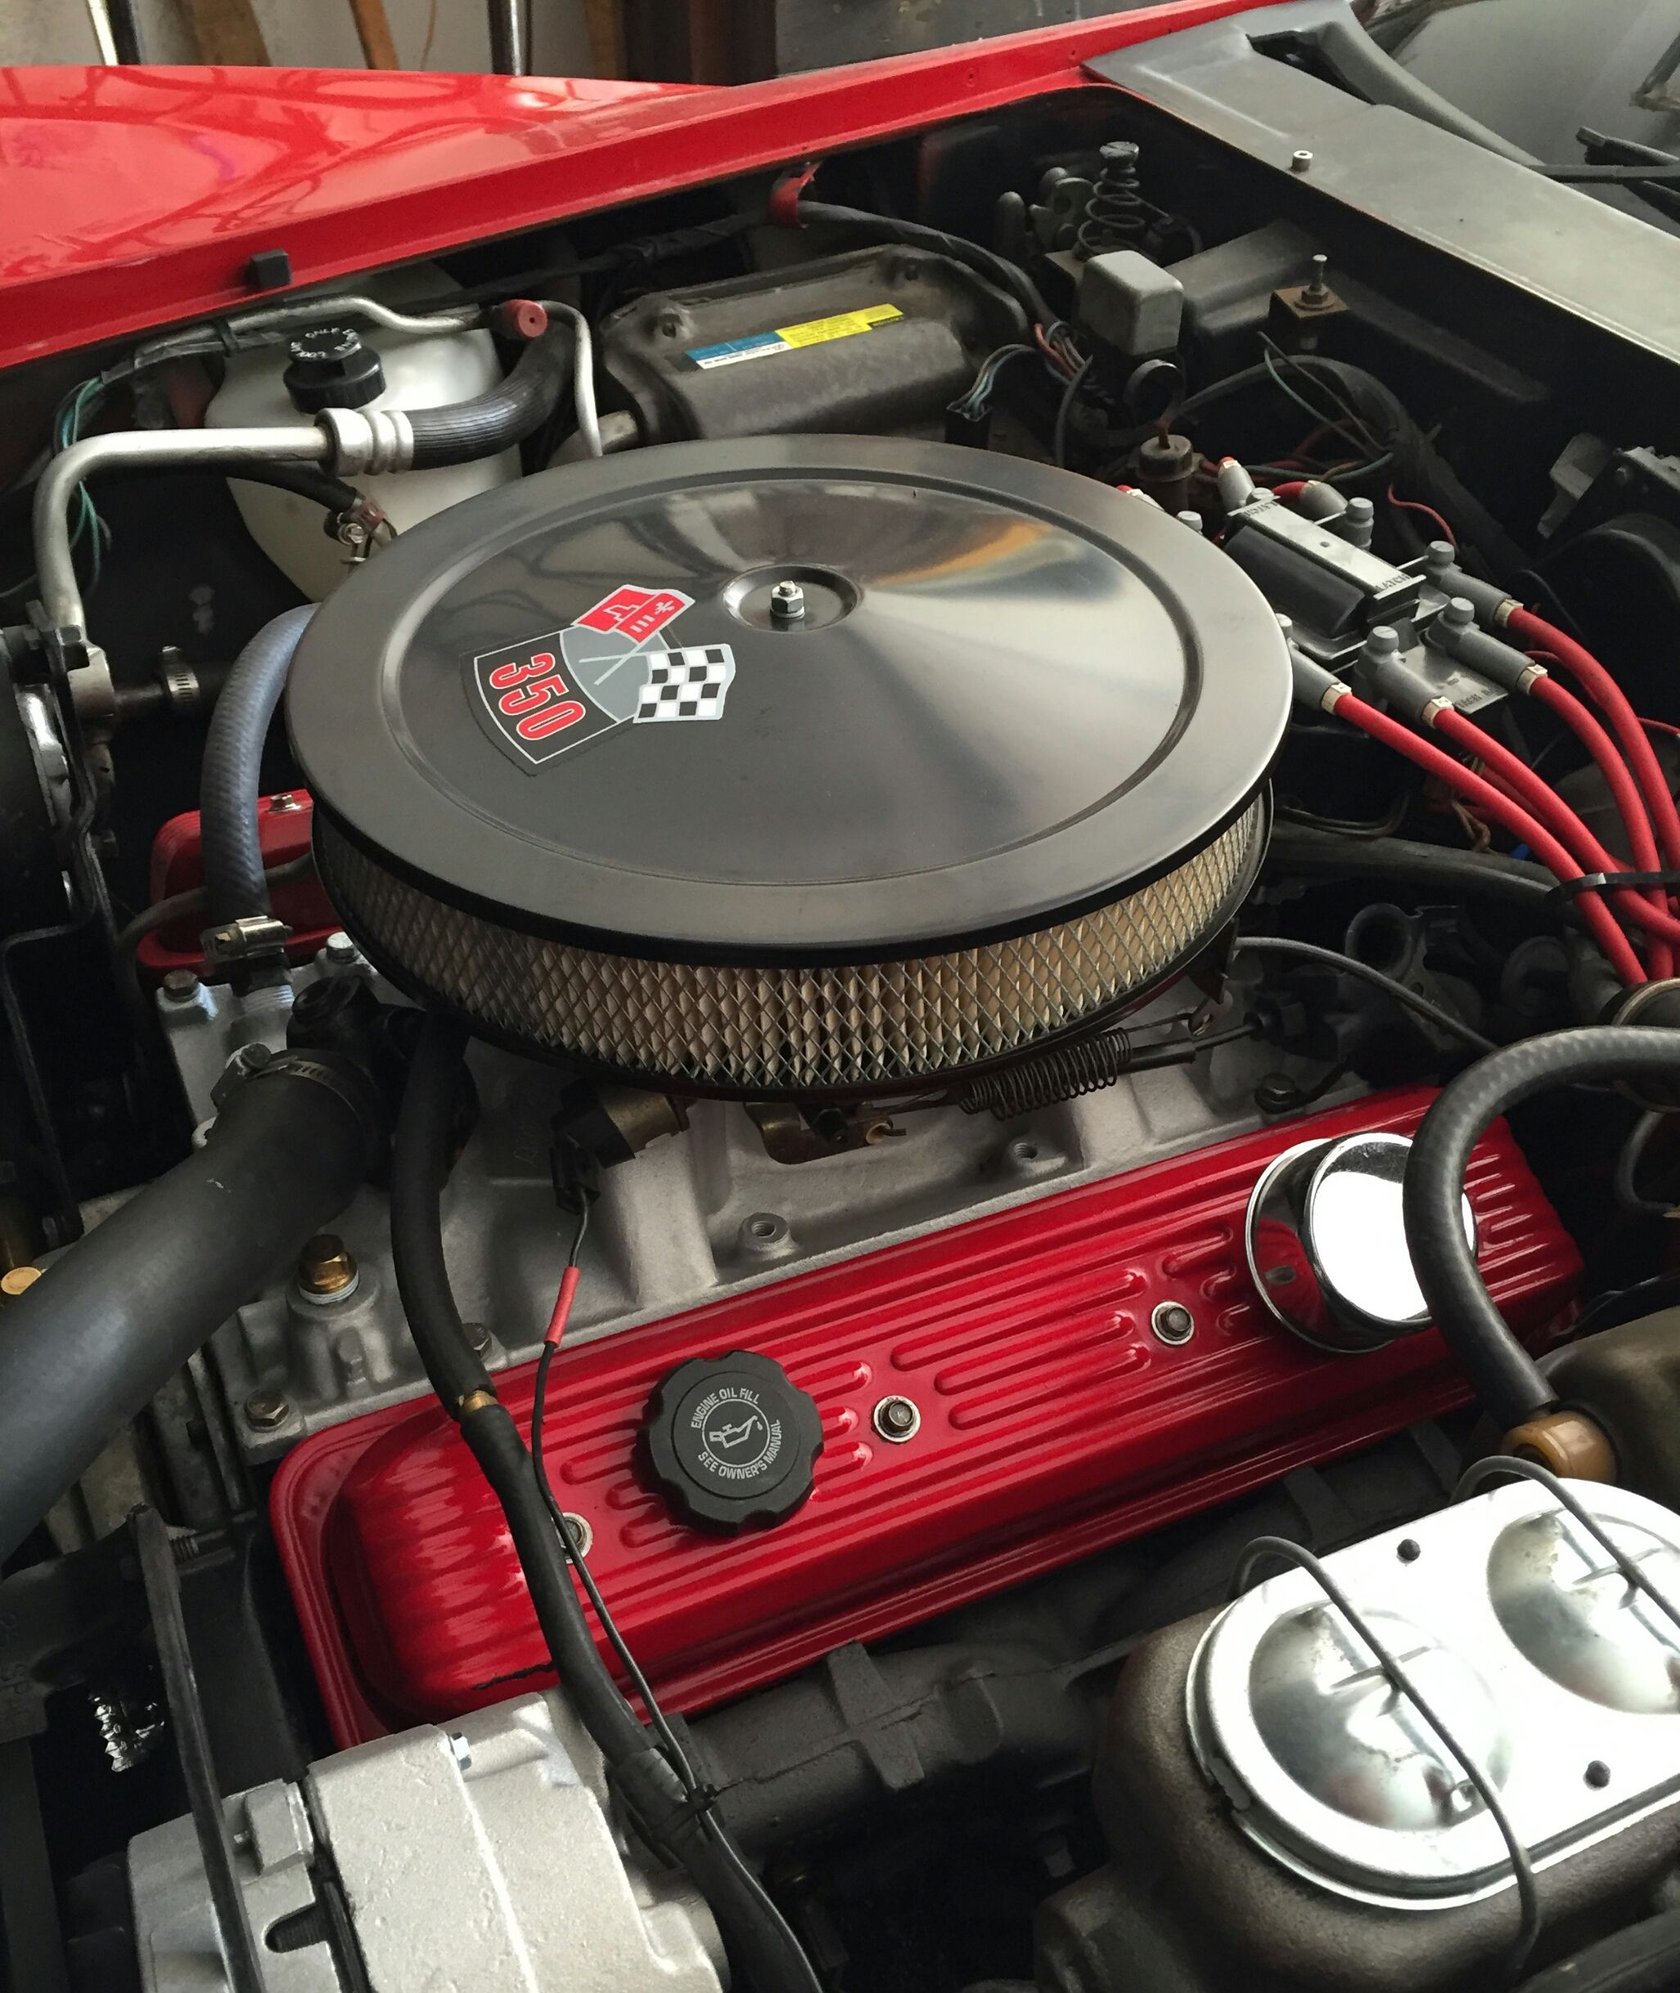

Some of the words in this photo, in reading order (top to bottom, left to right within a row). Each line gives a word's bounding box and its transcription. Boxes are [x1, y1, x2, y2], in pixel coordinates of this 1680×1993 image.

[1375, 573, 1411, 591] LATCH
[489, 652, 586, 740] 350
[691, 1392, 720, 1429] ENGINE
[719, 1387, 738, 1399] OIL
[739, 1388, 760, 1405] FILL
[698, 1451, 718, 1472] SEE
[718, 1461, 768, 1479] OWNER'S
[765, 1419, 782, 1464] MANUAL
